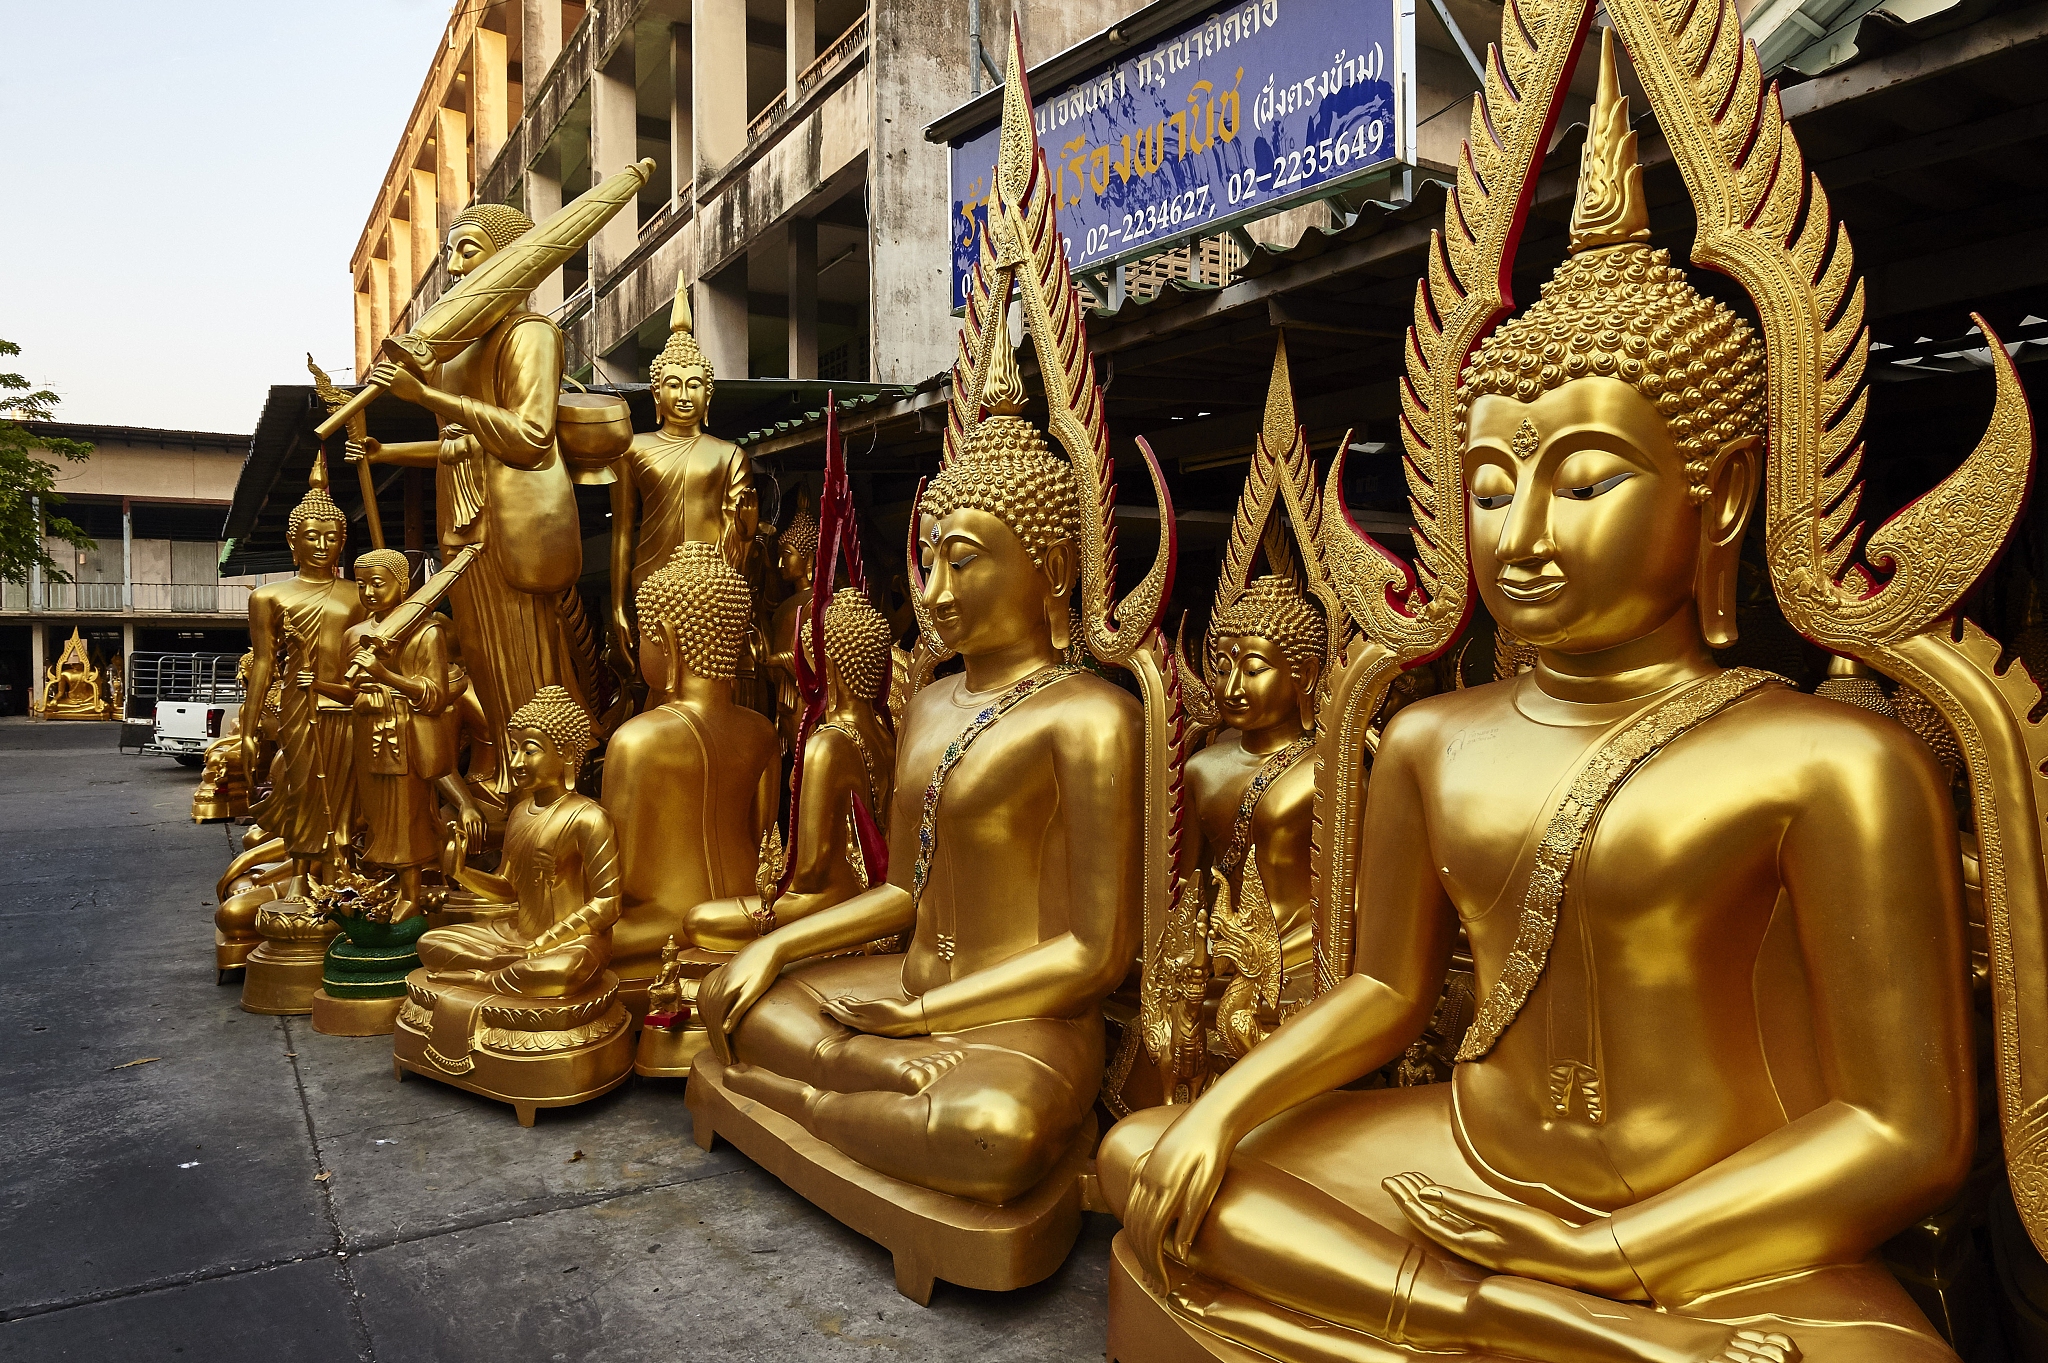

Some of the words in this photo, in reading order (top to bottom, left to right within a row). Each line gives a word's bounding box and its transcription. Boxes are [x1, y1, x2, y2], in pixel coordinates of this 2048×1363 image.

[1033, 61, 1126, 137] นใจสินค้า
[1137, 0, 1279, 89] กรุณาติดตอ
[1052, 66, 1245, 211] เรืองพานิช
[1253, 41, 1384, 131] (ฝั่งตรงข้าม)
[1227, 119, 1384, 205] 02-2235649
